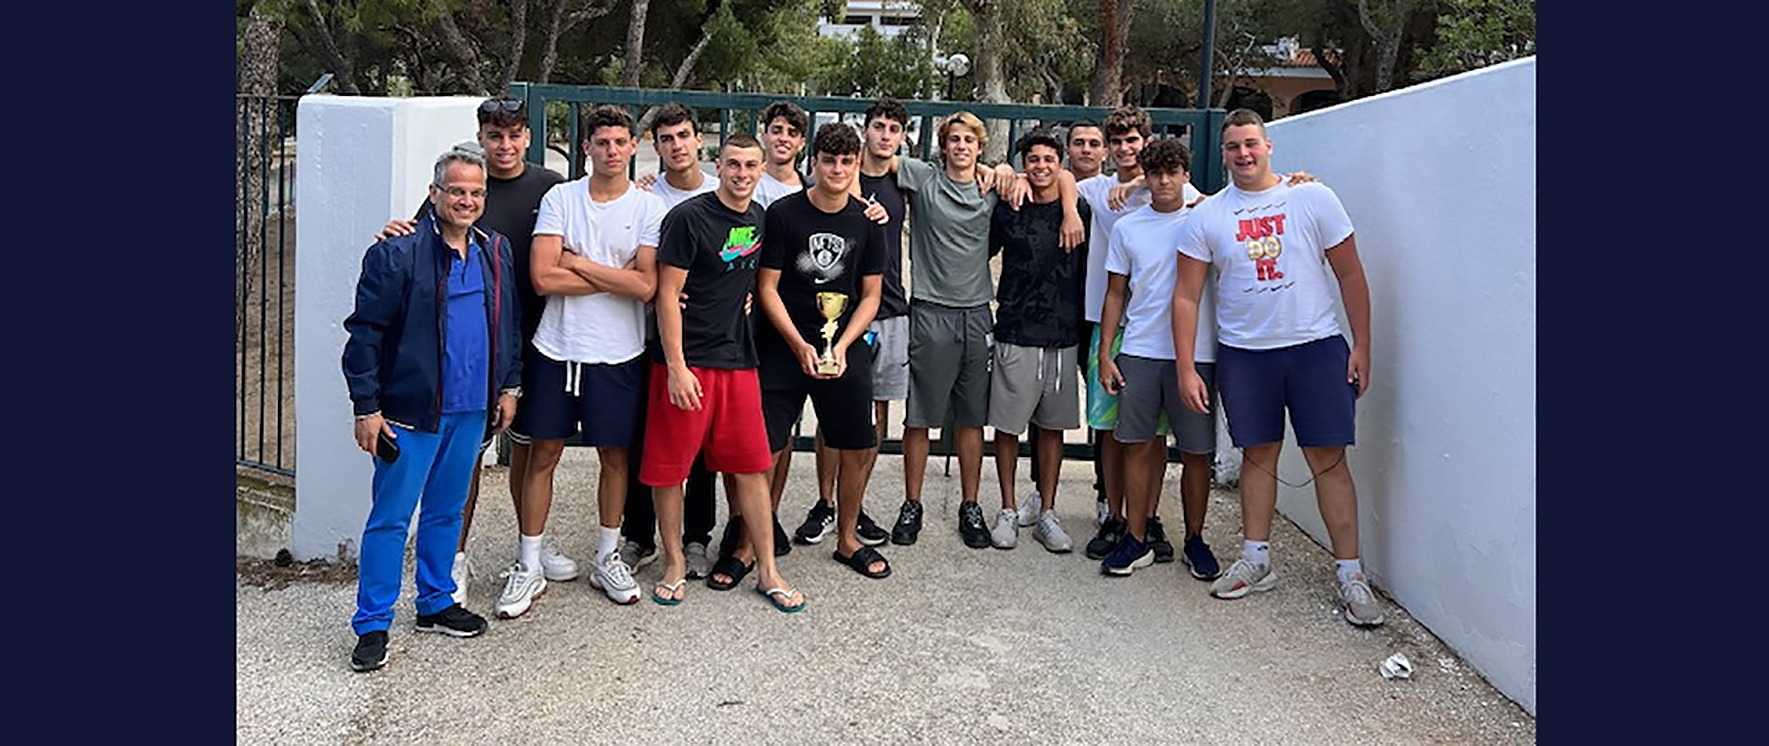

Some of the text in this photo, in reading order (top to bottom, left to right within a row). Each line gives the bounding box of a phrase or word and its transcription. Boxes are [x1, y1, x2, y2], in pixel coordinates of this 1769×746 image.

[1236, 214, 1285, 241] JUST
[1247, 235, 1282, 261] DO
[1256, 259, 1284, 281] IT.
